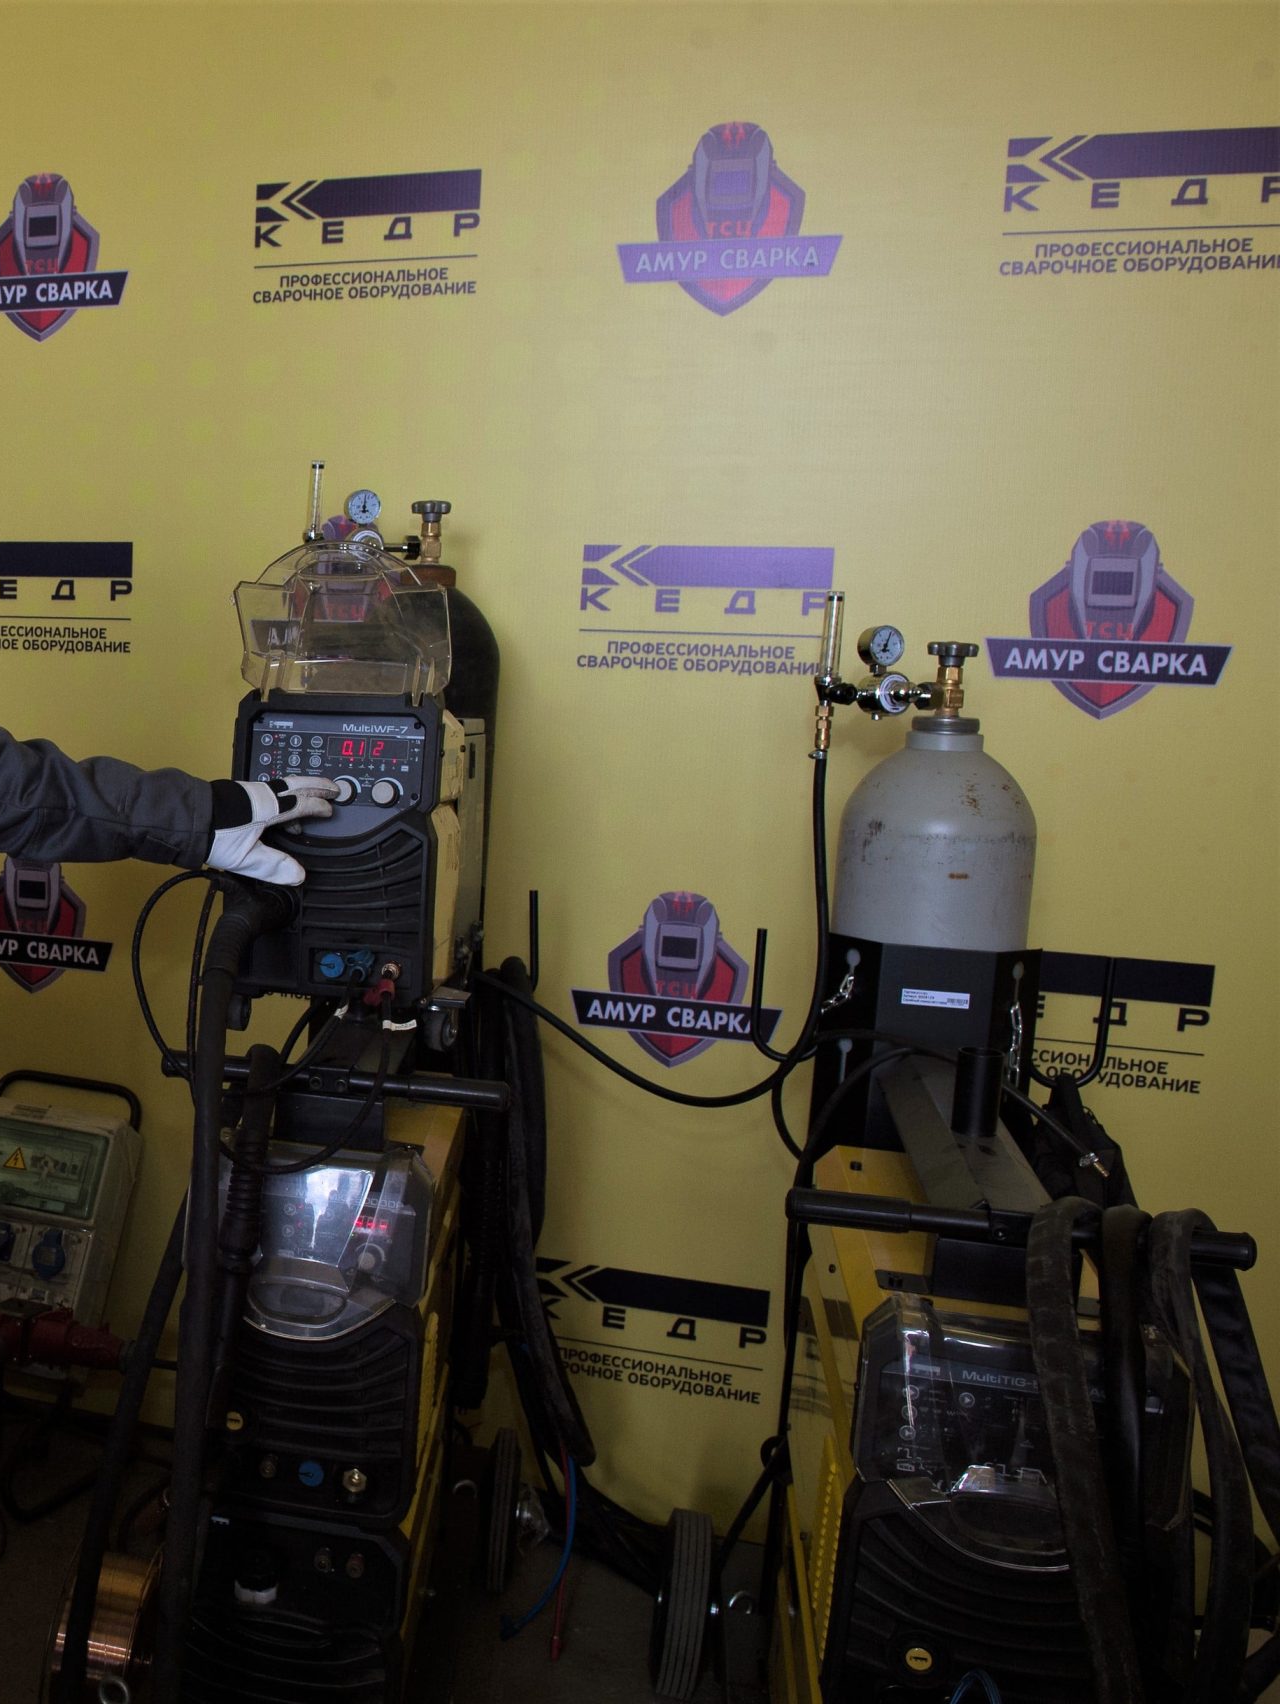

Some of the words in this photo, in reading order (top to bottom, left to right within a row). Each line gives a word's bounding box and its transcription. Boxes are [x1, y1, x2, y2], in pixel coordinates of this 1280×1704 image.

[255, 213, 480, 248] КЕДР
[635, 251, 708, 273] АМУР
[720, 246, 820, 270] СВАРКА
[1035, 238, 1253, 258] ПРОФЕССИОНАЛЬНОЕ
[999, 258, 1117, 276] СВАРОЧНОЕ
[1123, 254, 1280, 275] ОБОРУДОВАНИ
[280, 268, 449, 288] ПРОФЕССИОНАЛЬНОЕ
[36, 279, 113, 303] СВАРКА
[253, 287, 344, 304] СВАРОЧНОЕ
[348, 281, 477, 300] ОБОРУДОВАНИЕ
[580, 587, 827, 616] КЕДР
[22, 639, 131, 654] ОБОРУДОВАНИЕ
[607, 641, 795, 660] ПРОФЕССИОНАЛЬНОЕ
[577, 655, 677, 671] СВАРОЧНОЕ
[683, 657, 821, 676] ОБОРУДОВАНИ
[1004, 647, 1086, 671] АМУР
[1097, 650, 1208, 677] СВАРКА
[342, 723, 408, 734] MultiWF-7
[27, 941, 100, 965] СВАРКА
[587, 999, 657, 1024] АМУР
[559, 1347, 732, 1386] ПРОФЕССИОНАЛЬНОЕ
[562, 1361, 623, 1381] РОЧНОЕ
[628, 1371, 761, 1404] ОБОРУДОВАНИЕ
